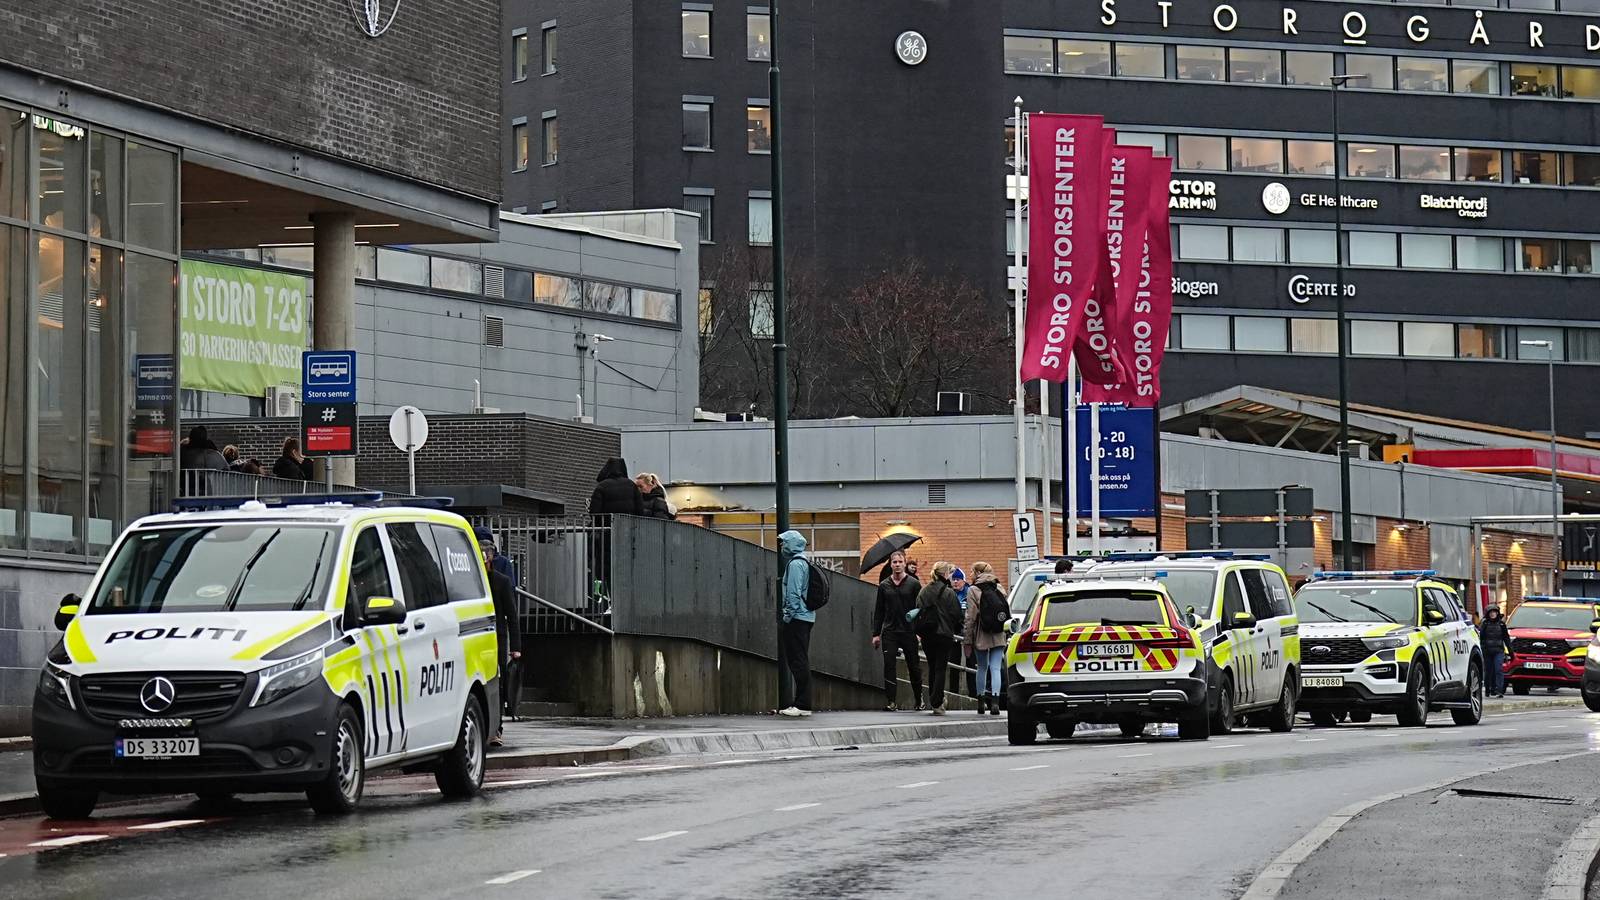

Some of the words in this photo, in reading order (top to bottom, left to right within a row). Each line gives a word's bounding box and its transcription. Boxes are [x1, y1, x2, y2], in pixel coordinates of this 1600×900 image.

[1101, 0, 1600, 51] STOROGÅRD
[1169, 179, 1216, 196] CTOR
[1054, 127, 1076, 285] STORSENTER
[1169, 196, 1201, 210] ARM
[1300, 193, 1317, 206] GE
[1420, 194, 1484, 210] Blatchford
[1458, 209, 1488, 218] Ortopedi
[193, 274, 256, 328] STORO
[264, 285, 303, 334] 7-23
[1040, 293, 1072, 369] STORO
[1133, 321, 1153, 397] STORO
[307, 390, 327, 398] Storo
[1110, 431, 1126, 442] 20
[1085, 446, 1105, 461] (0
[1115, 445, 1135, 460] 18)
[1122, 473, 1131, 482] på
[1018, 517, 1030, 542] P
[104, 626, 248, 645] POLITI
[1086, 645, 1099, 655] DS
[1103, 644, 1130, 655] 16681
[1074, 660, 1139, 672] POLITI
[1260, 649, 1279, 671] POLITI
[419, 660, 455, 697] POLITI
[1315, 678, 1341, 687] 84080
[127, 740, 145, 755] DS
[151, 739, 195, 754] 33207
